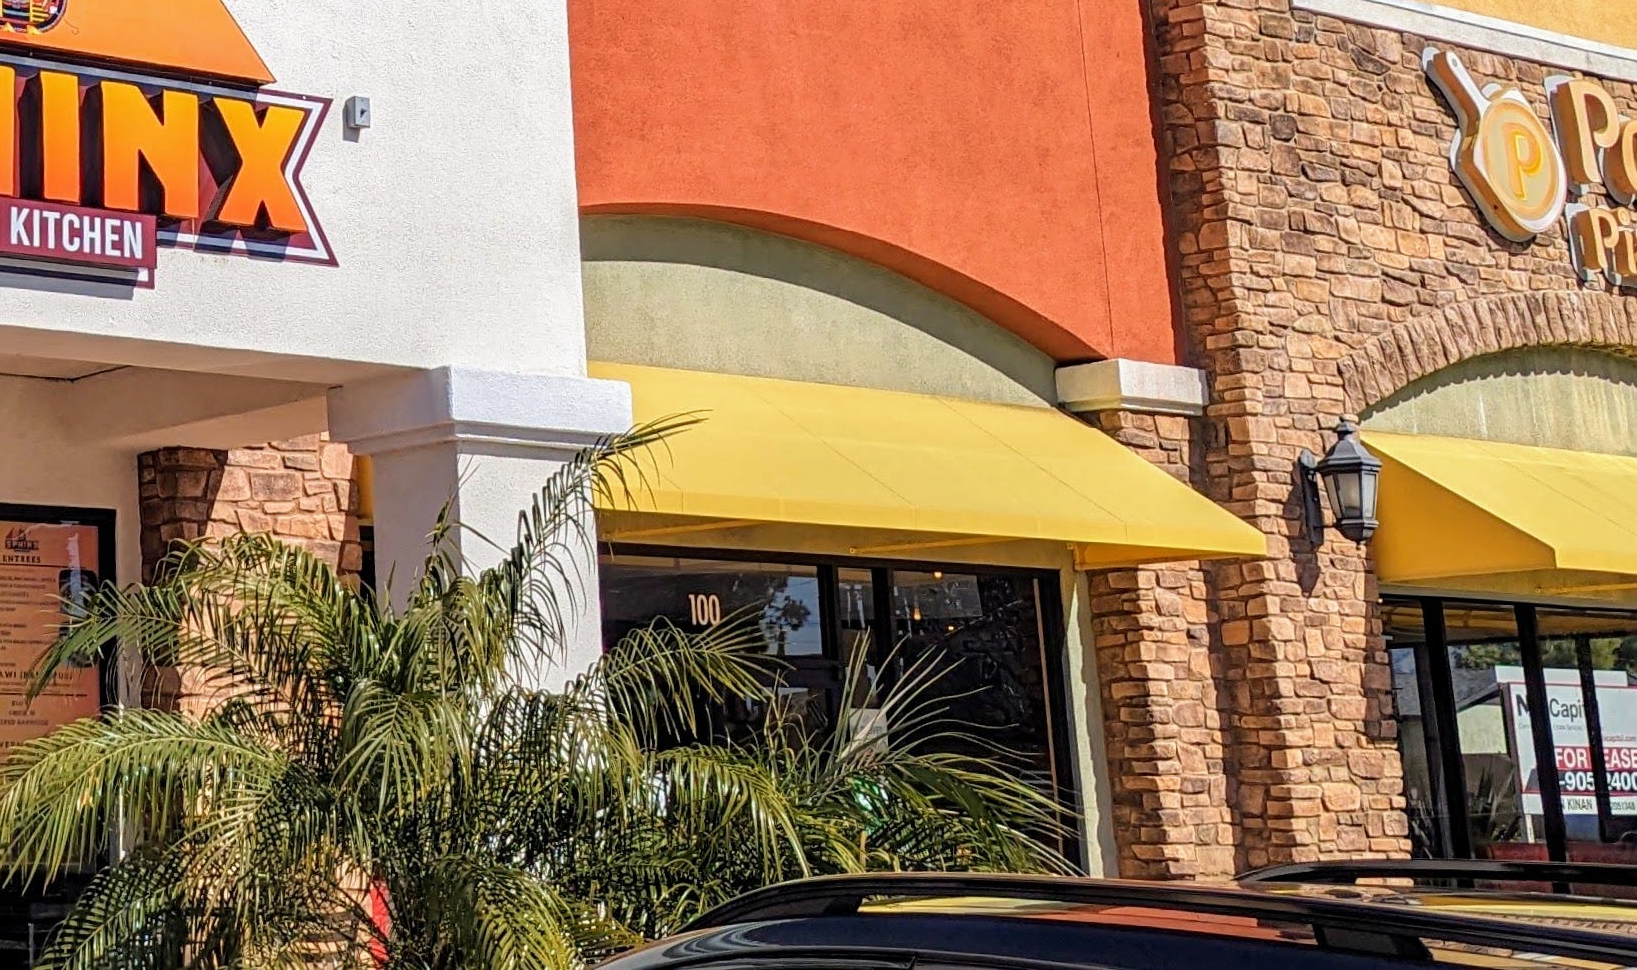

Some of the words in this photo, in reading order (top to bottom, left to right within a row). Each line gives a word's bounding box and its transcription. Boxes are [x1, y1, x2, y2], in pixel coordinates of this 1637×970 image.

[1509, 129, 1544, 201] P
[9, 207, 144, 260] KITCHEN
[2, 555, 41, 563] ENTREES
[688, 594, 721, 626] 100
[1549, 698, 1583, 722] Capi
[1555, 748, 1588, 769] FOR
[1604, 749, 1637, 769] EASE
